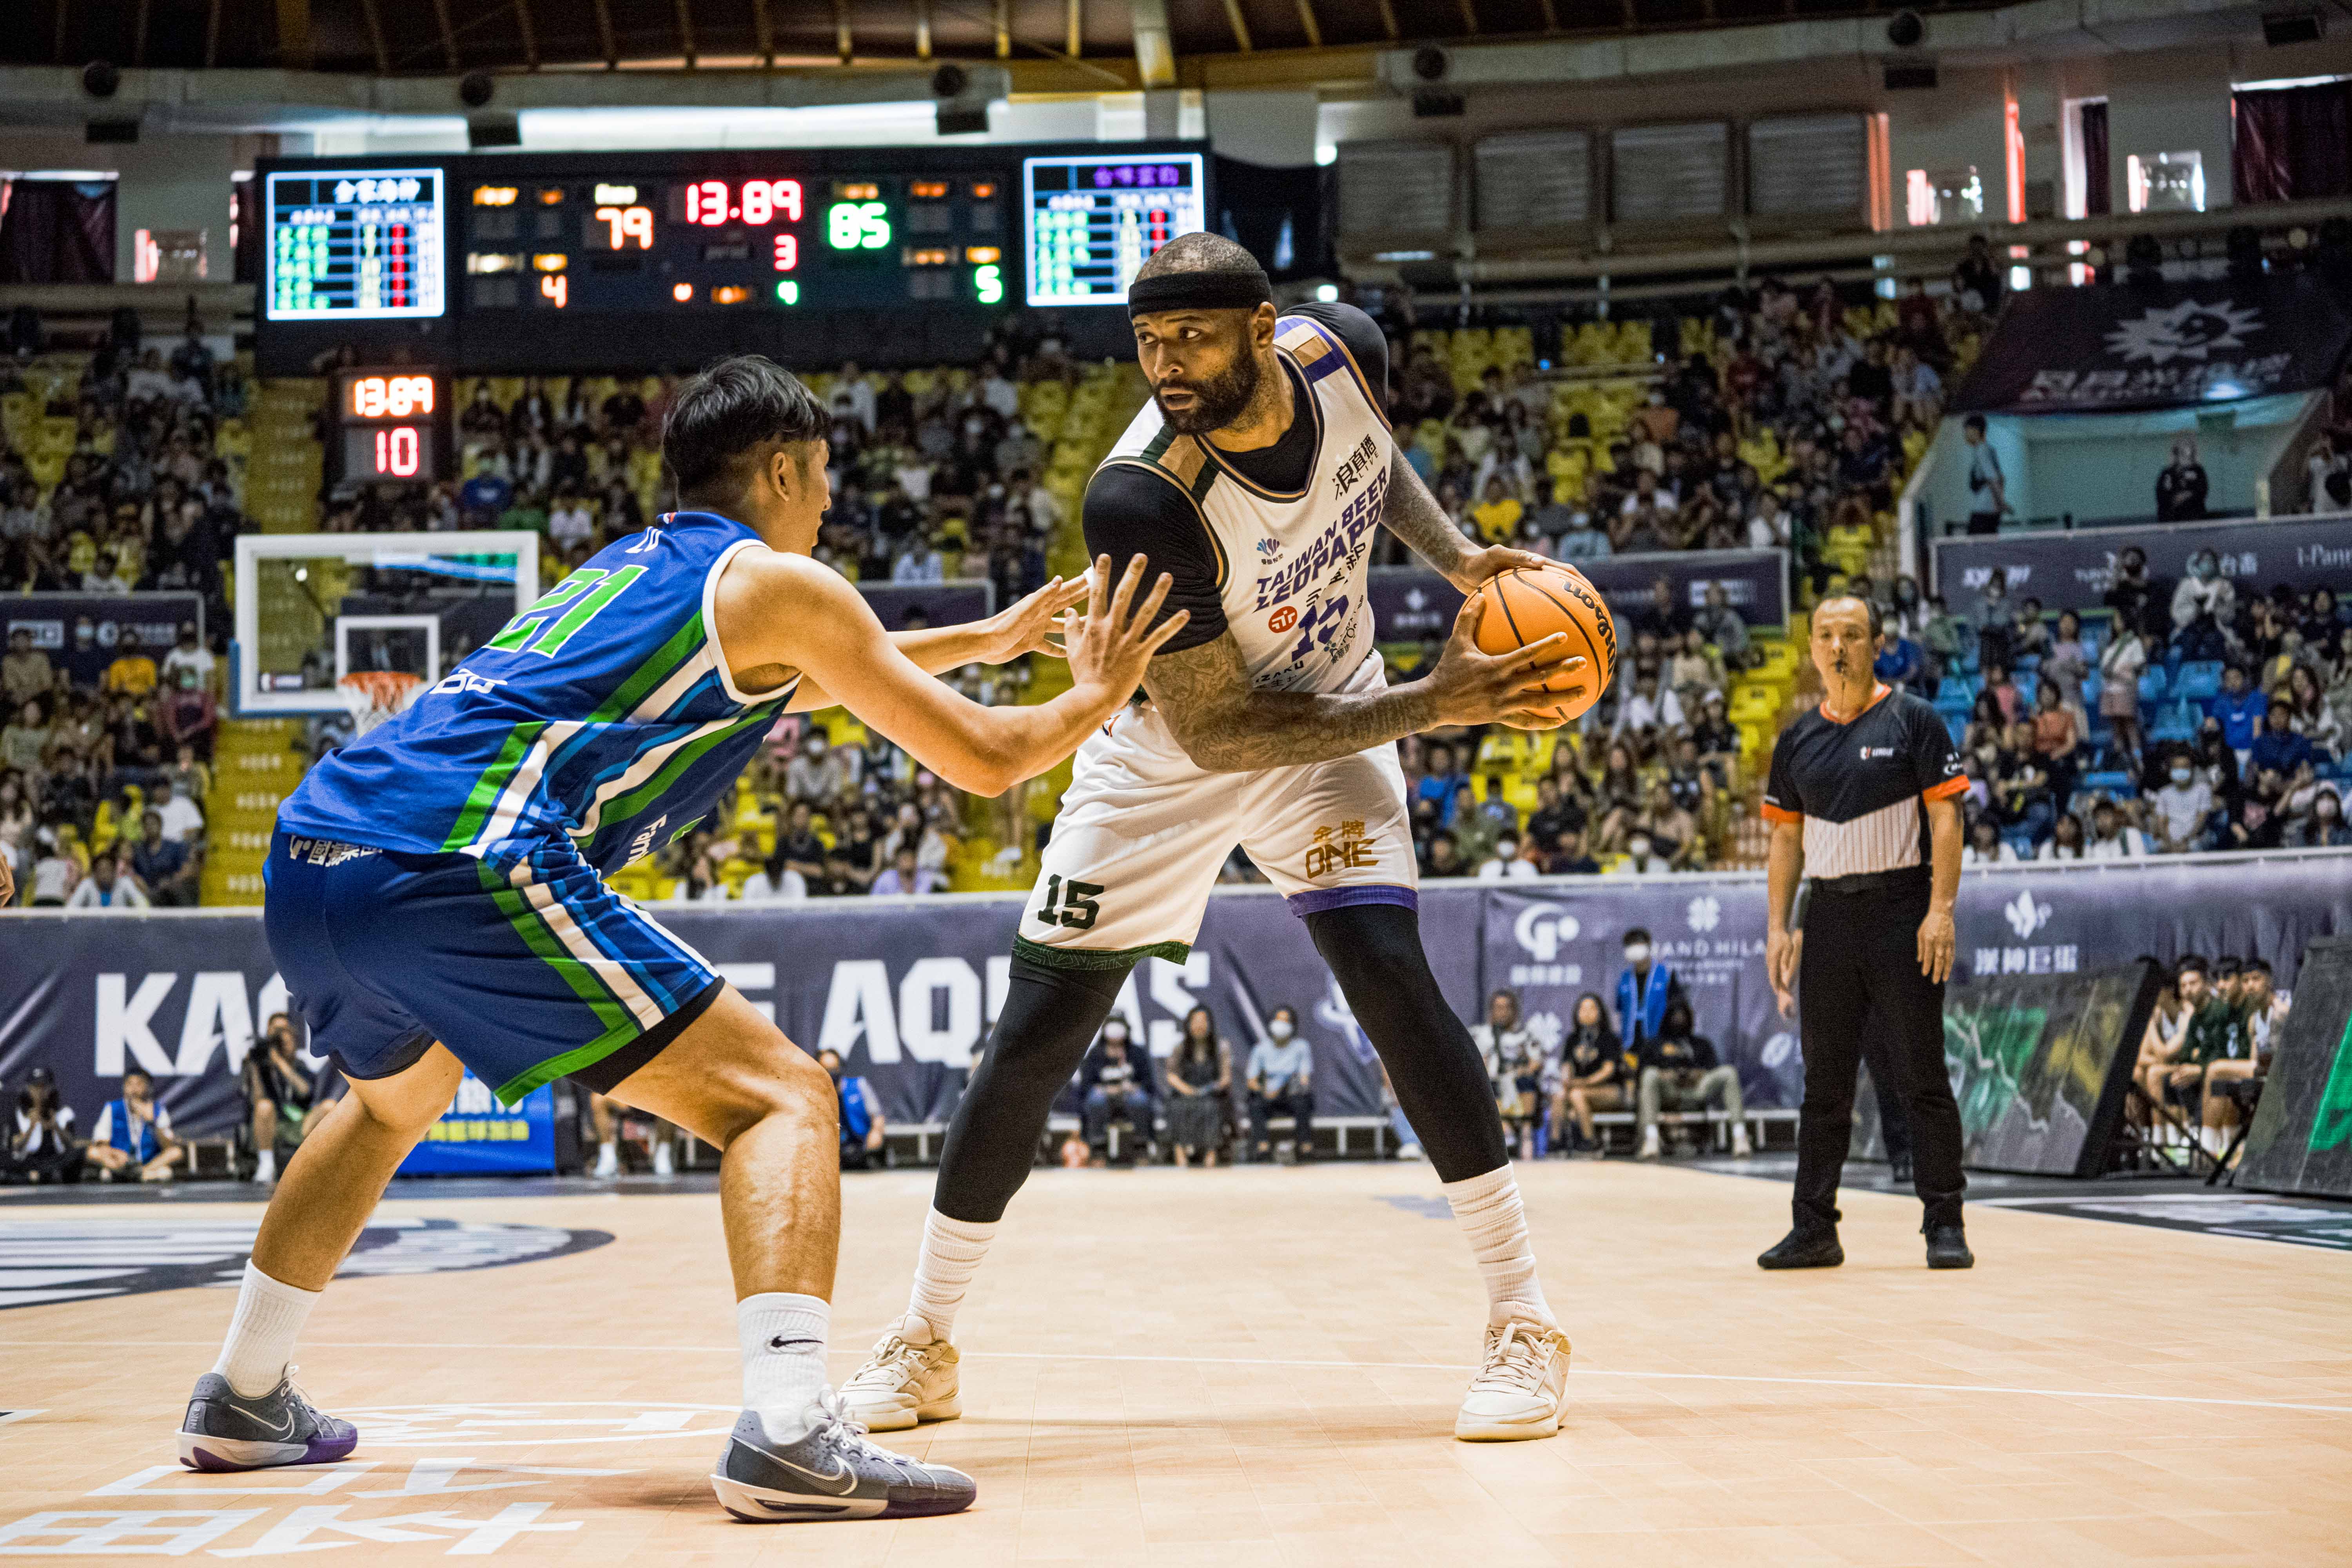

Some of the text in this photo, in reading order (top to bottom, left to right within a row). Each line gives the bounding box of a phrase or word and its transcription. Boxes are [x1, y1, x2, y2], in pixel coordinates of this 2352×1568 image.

[686, 179, 802, 227] 13.89
[596, 207, 653, 250] 79
[829, 202, 891, 249] 85
[773, 234, 798, 271] 3
[541, 275, 567, 308] 4
[974, 264, 1003, 303] 5
[354, 374, 433, 417] 13.89
[376, 426, 419, 477] 10
[1332, 434, 1376, 501] 浪直播
[1359, 451, 1379, 478] LIVE
[1257, 519, 1337, 594] TAIWAN
[1342, 466, 1387, 530] BEER
[483, 564, 649, 659] 21
[1314, 820, 1365, 843] 金牌
[1305, 838, 1379, 879] ONE
[1037, 874, 1105, 930] 15
[188, 1406, 201, 1430] NIKE
